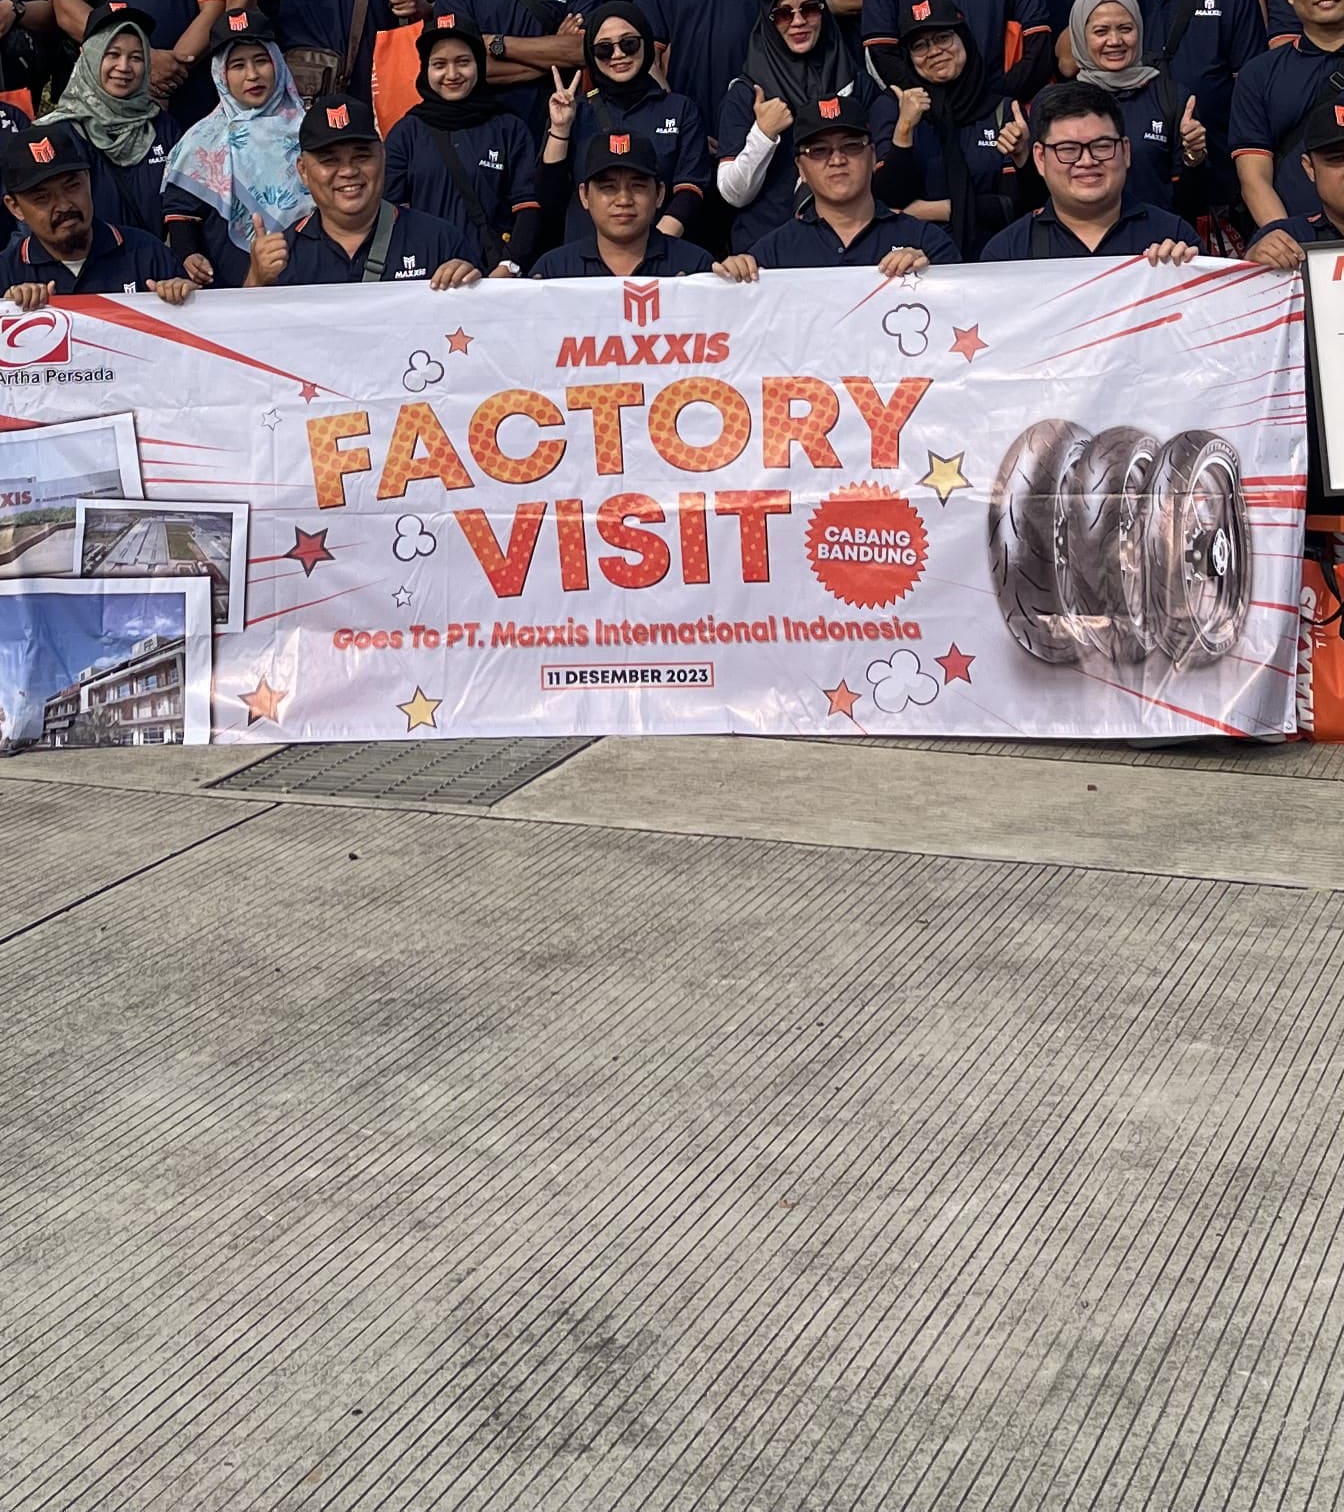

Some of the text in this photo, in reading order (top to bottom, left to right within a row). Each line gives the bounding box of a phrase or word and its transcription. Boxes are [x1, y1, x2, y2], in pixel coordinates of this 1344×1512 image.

[556, 332, 731, 369] MAXXIS
[46, 367, 114, 384] Persada
[306, 375, 935, 510] FACTORY
[453, 489, 792, 599] VISIT
[824, 526, 911, 547] CABANG
[817, 543, 917, 566] BANDUNG
[333, 614, 923, 650] Goes To PT. Maxxis International Indonesia
[547, 668, 709, 686] 11 DESEMBER 2023
